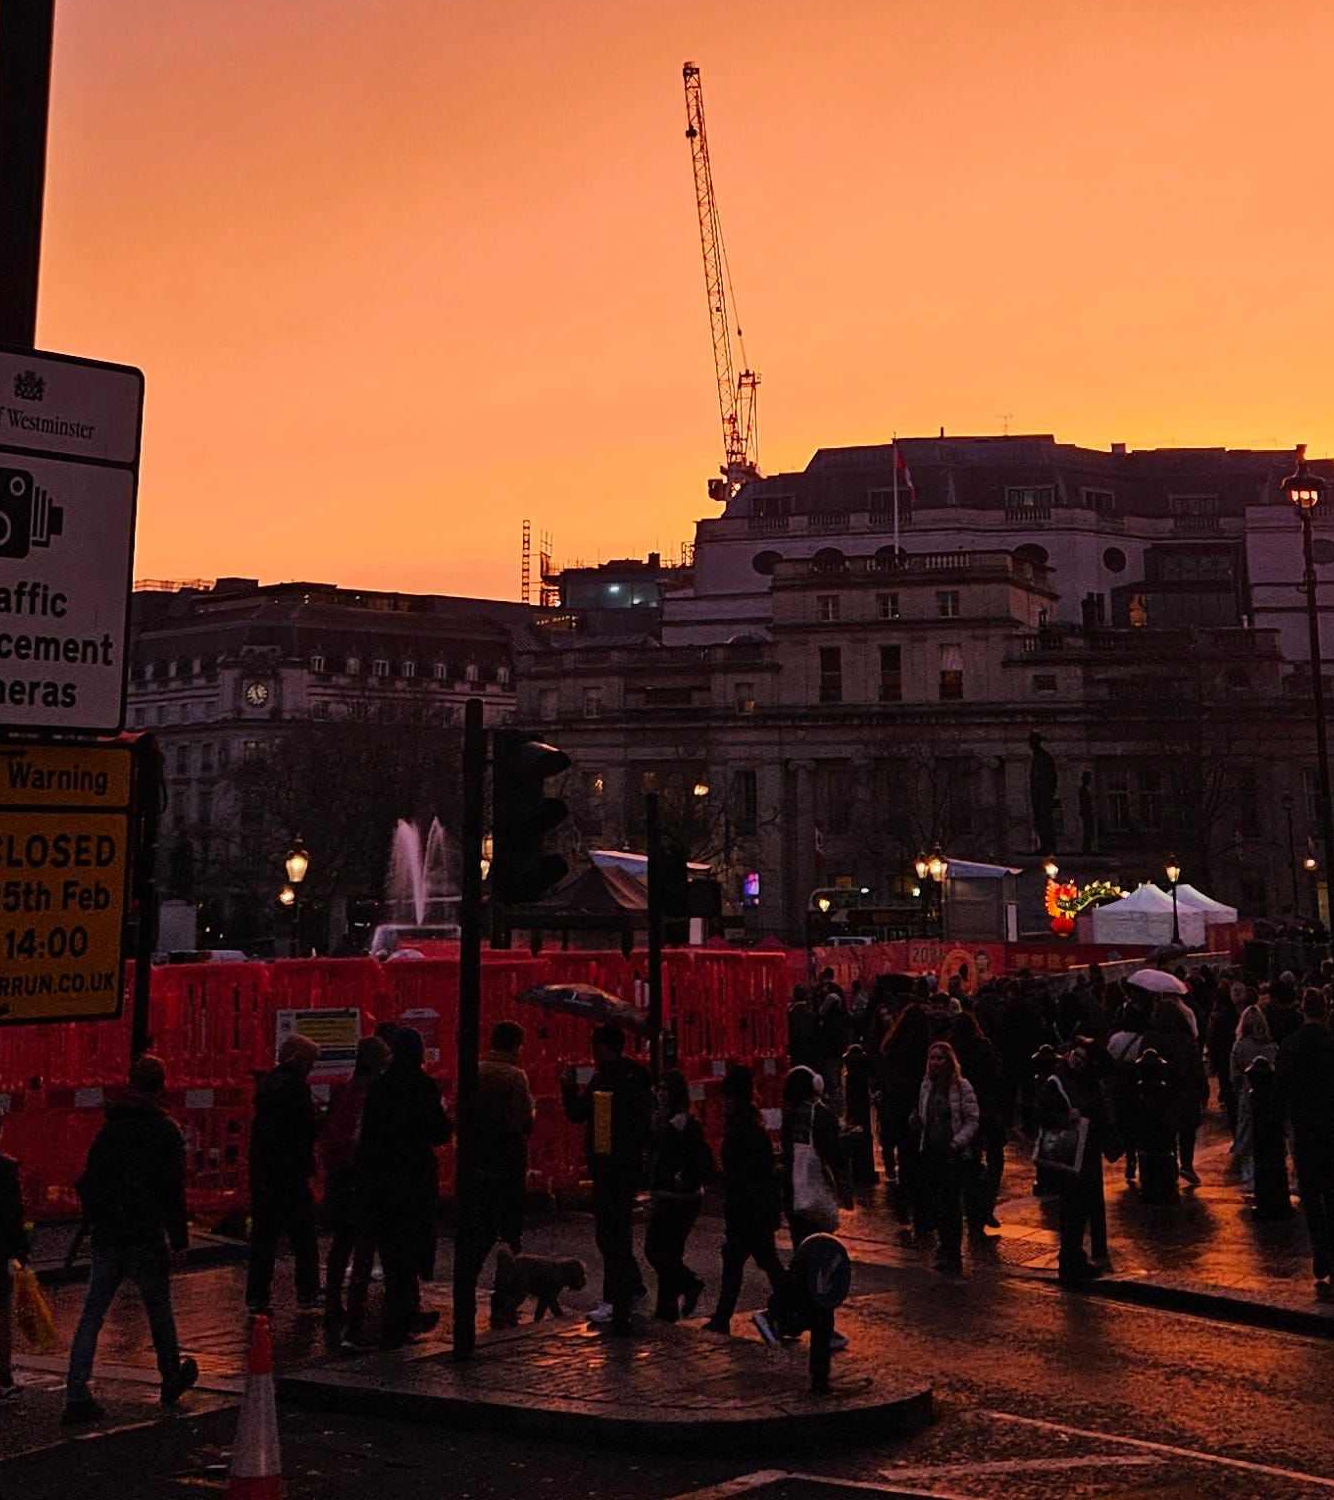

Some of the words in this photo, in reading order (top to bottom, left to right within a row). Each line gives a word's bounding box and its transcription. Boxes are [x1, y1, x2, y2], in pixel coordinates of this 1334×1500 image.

[7, 408, 96, 440] Westminster
[8, 761, 109, 796] Warning
[62, 880, 110, 911] Feb
[5, 925, 88, 960] 14:00
